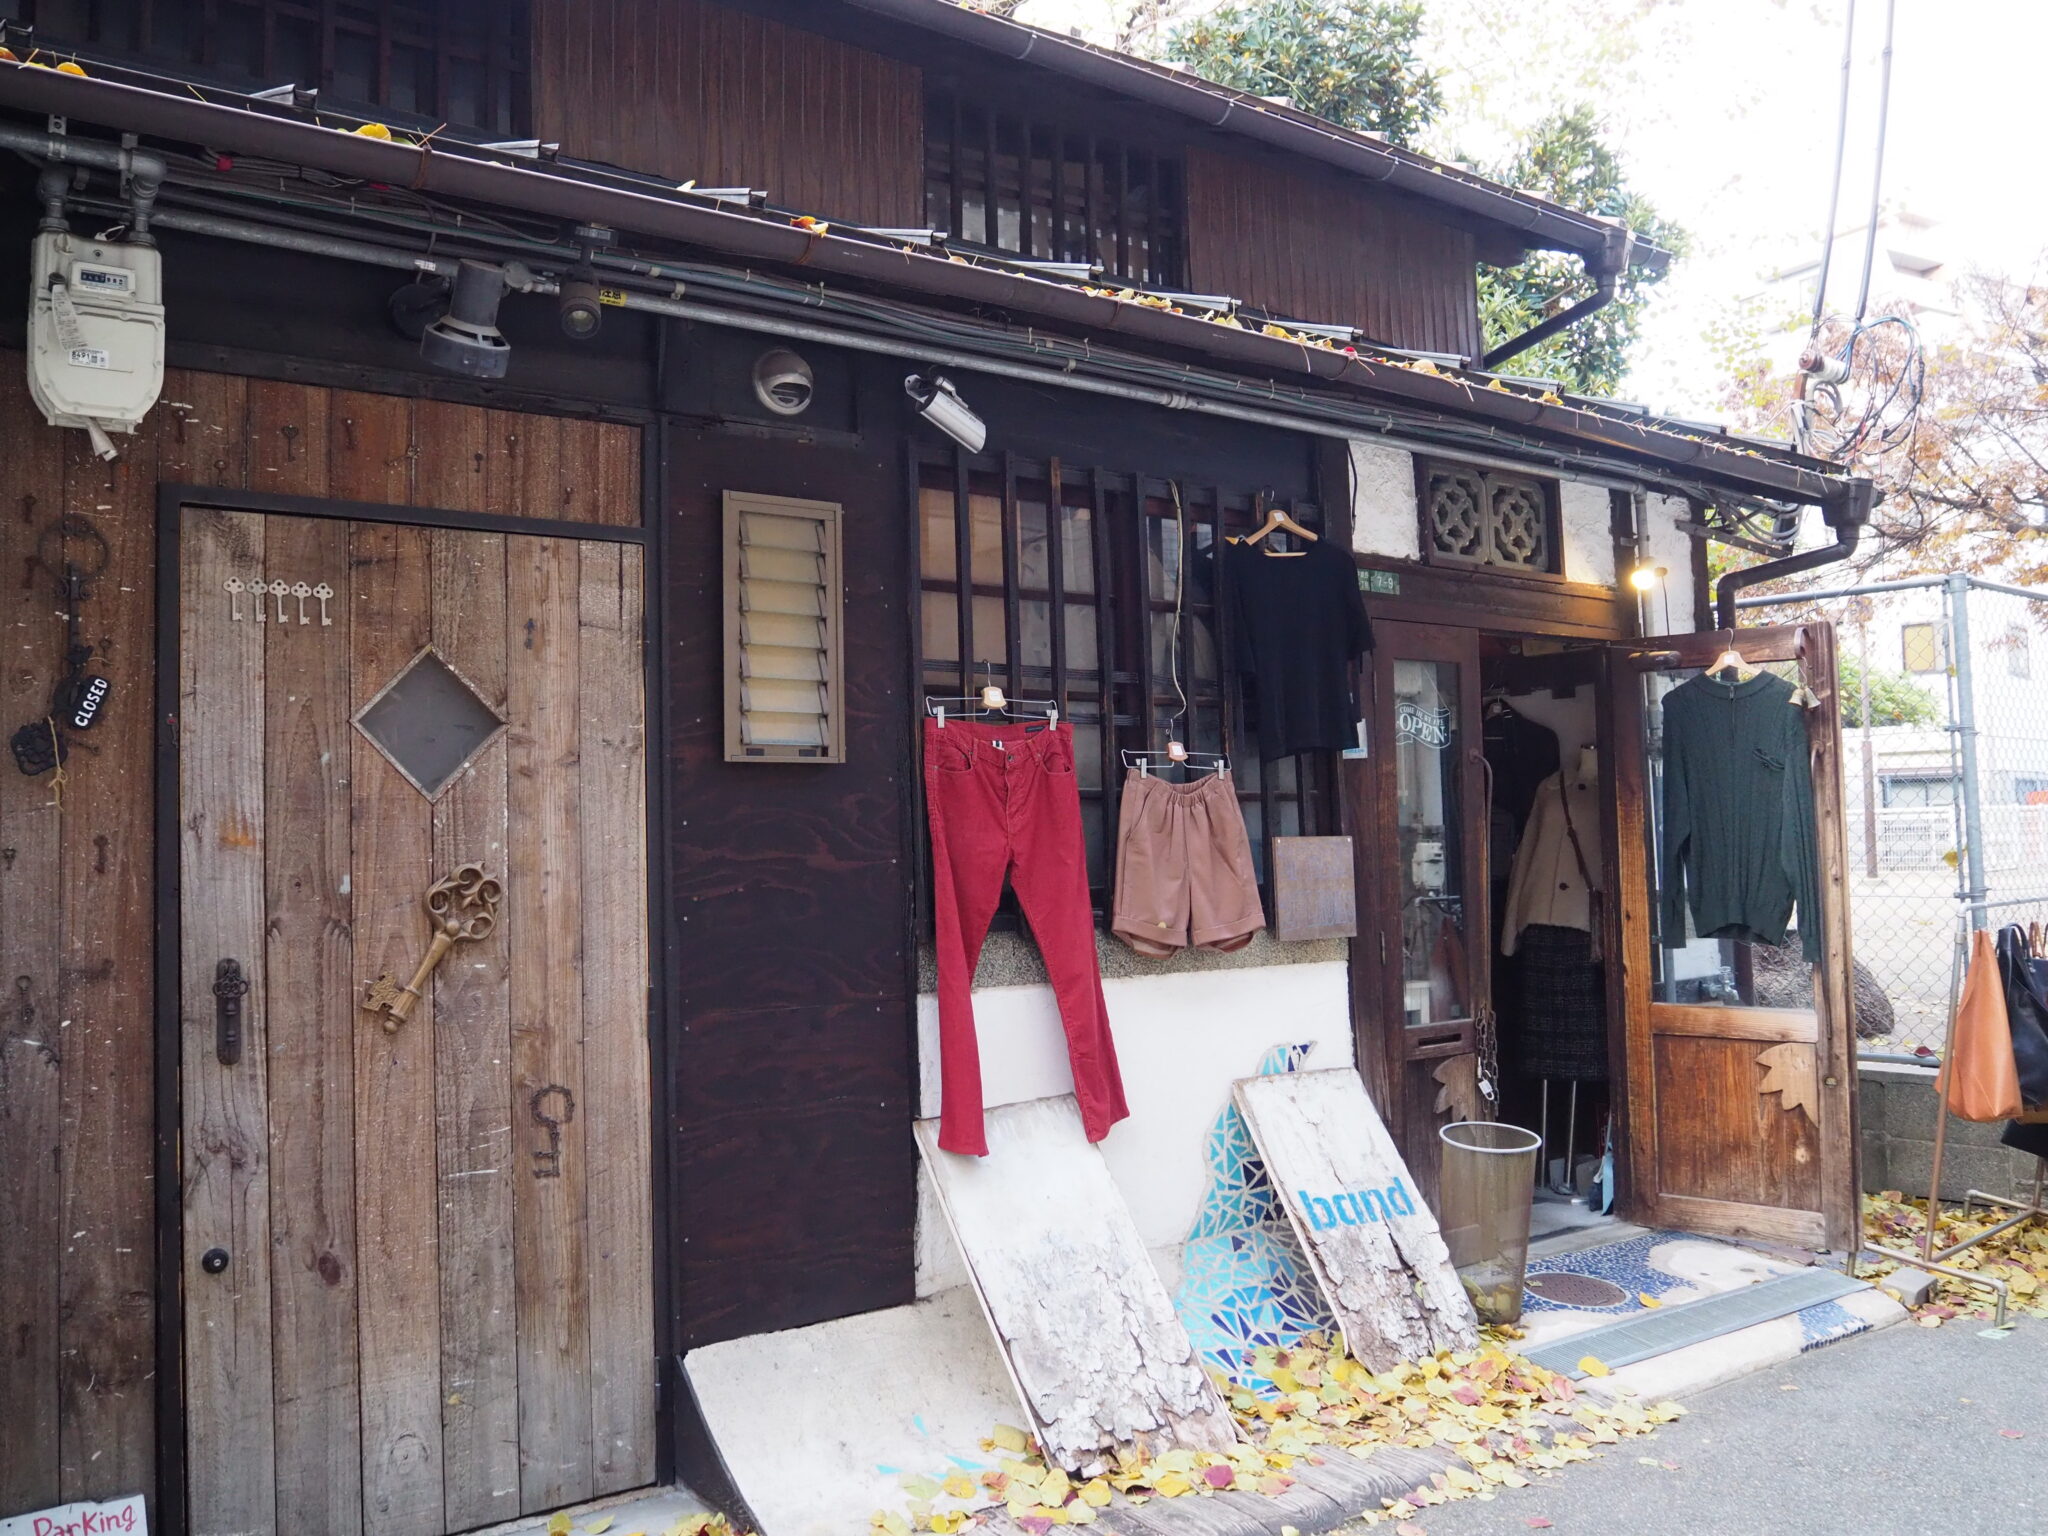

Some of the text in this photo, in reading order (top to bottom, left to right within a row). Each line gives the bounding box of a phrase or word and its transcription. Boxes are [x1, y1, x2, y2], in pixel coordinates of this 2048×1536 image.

[1377, 576, 1394, 589] 7-9
[75, 678, 108, 727] CLOSED
[1400, 713, 1446, 744] OPEN
[1297, 1176, 1416, 1232] band
